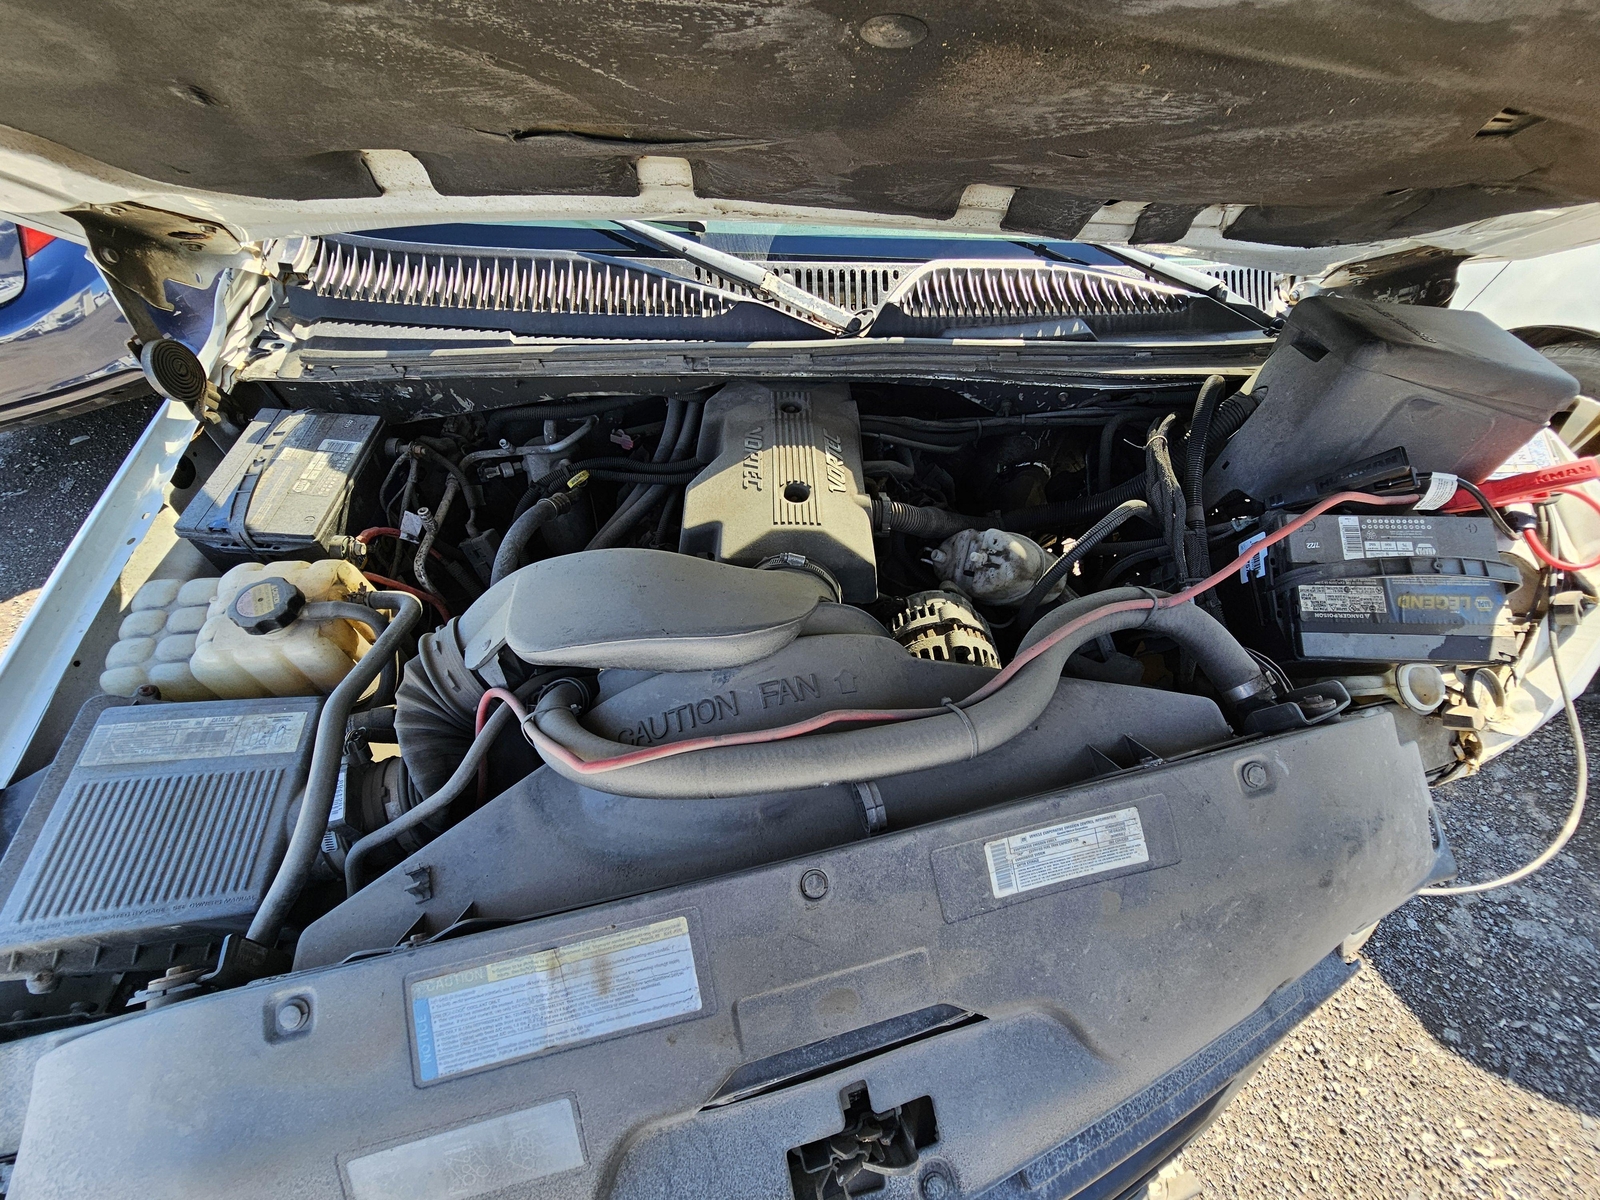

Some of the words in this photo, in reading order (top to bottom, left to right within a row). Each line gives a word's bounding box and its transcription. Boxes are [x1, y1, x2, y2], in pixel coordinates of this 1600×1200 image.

[742, 426, 764, 492] VORTEC
[822, 428, 847, 493] VORTEC
[1397, 594, 1471, 610] LEGEND
[617, 690, 739, 746] CAUTION
[756, 673, 821, 710] FAN
[426, 968, 483, 992] CAUTION
[416, 1013, 432, 1065] NOTICE
